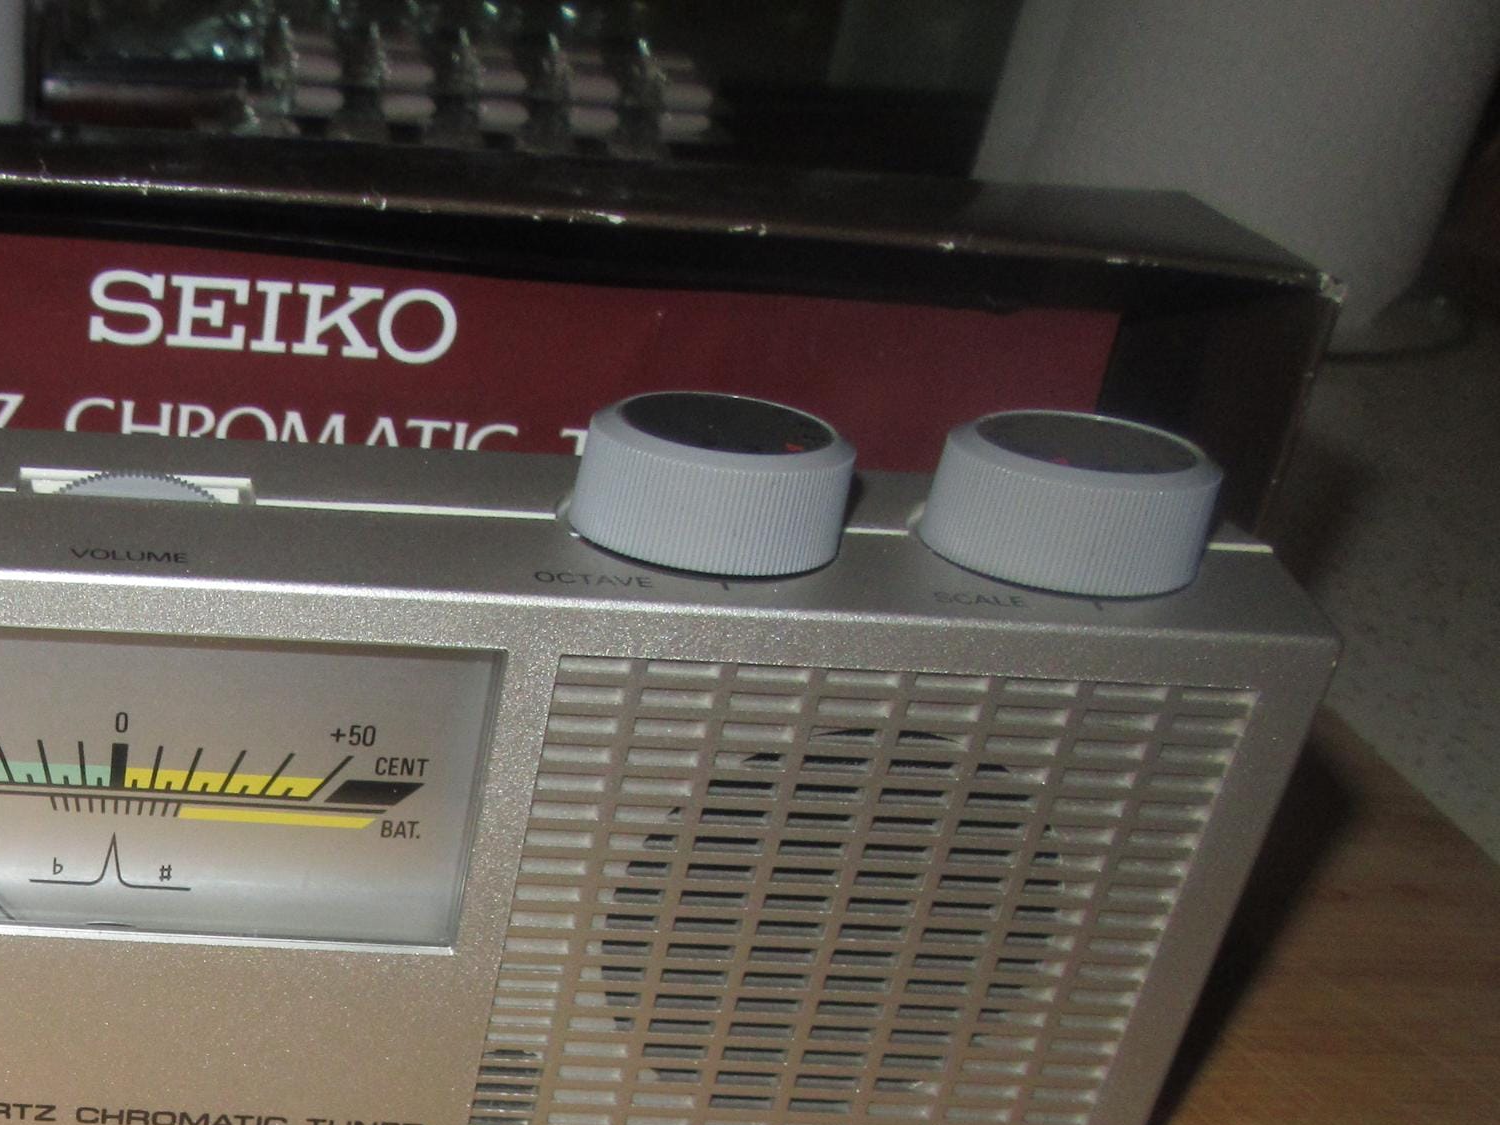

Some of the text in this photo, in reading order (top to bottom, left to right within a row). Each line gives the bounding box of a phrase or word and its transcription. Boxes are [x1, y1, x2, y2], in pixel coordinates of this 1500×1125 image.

[88, 269, 458, 365] SEIKO
[69, 547, 189, 564] VOLUME
[534, 570, 654, 588] OCTAVE
[933, 591, 1024, 608] SCALE
[115, 711, 129, 733] 0
[330, 724, 377, 747] +50
[374, 756, 430, 777] CENT
[380, 820, 420, 839] BAT.
